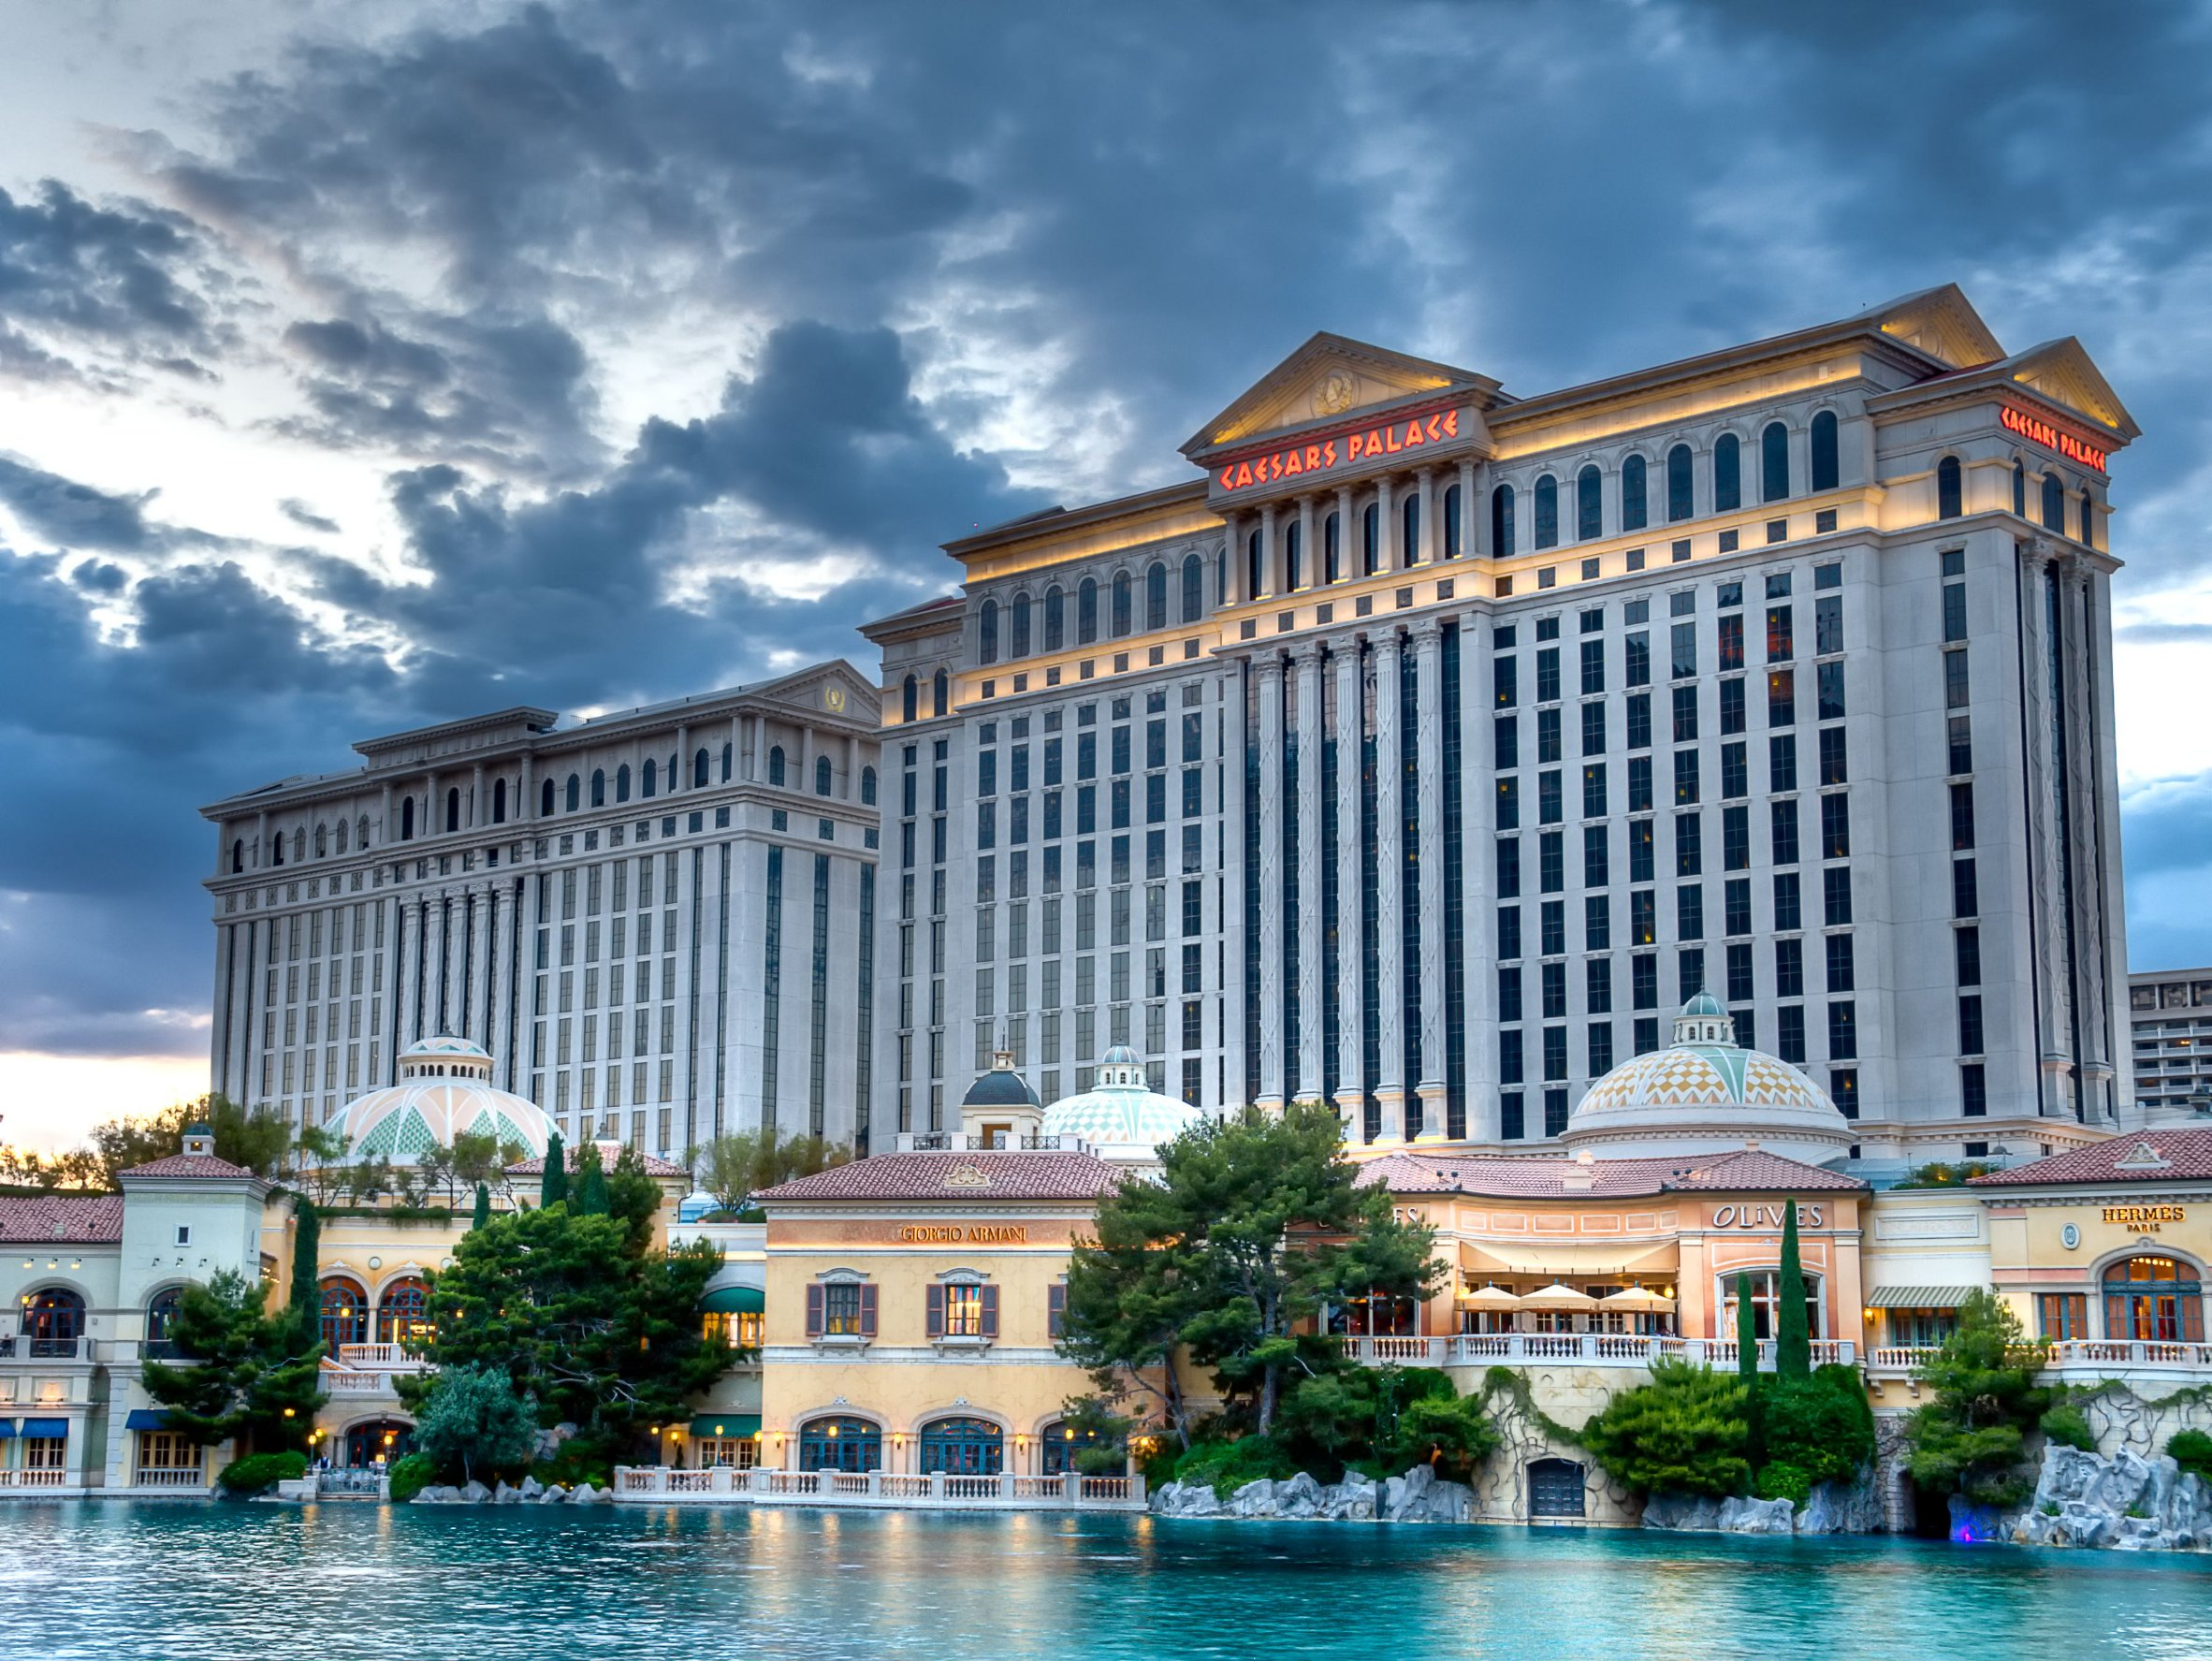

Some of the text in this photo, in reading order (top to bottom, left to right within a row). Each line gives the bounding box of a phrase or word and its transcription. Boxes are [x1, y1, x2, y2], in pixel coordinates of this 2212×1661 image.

[1219, 409, 1459, 491] CAESARS PALACE
[2001, 407, 2105, 473] CAESARS PALACE
[901, 1227, 1026, 1242] GIORGIO ARMANI
[2127, 1223, 2161, 1232] PARIS
